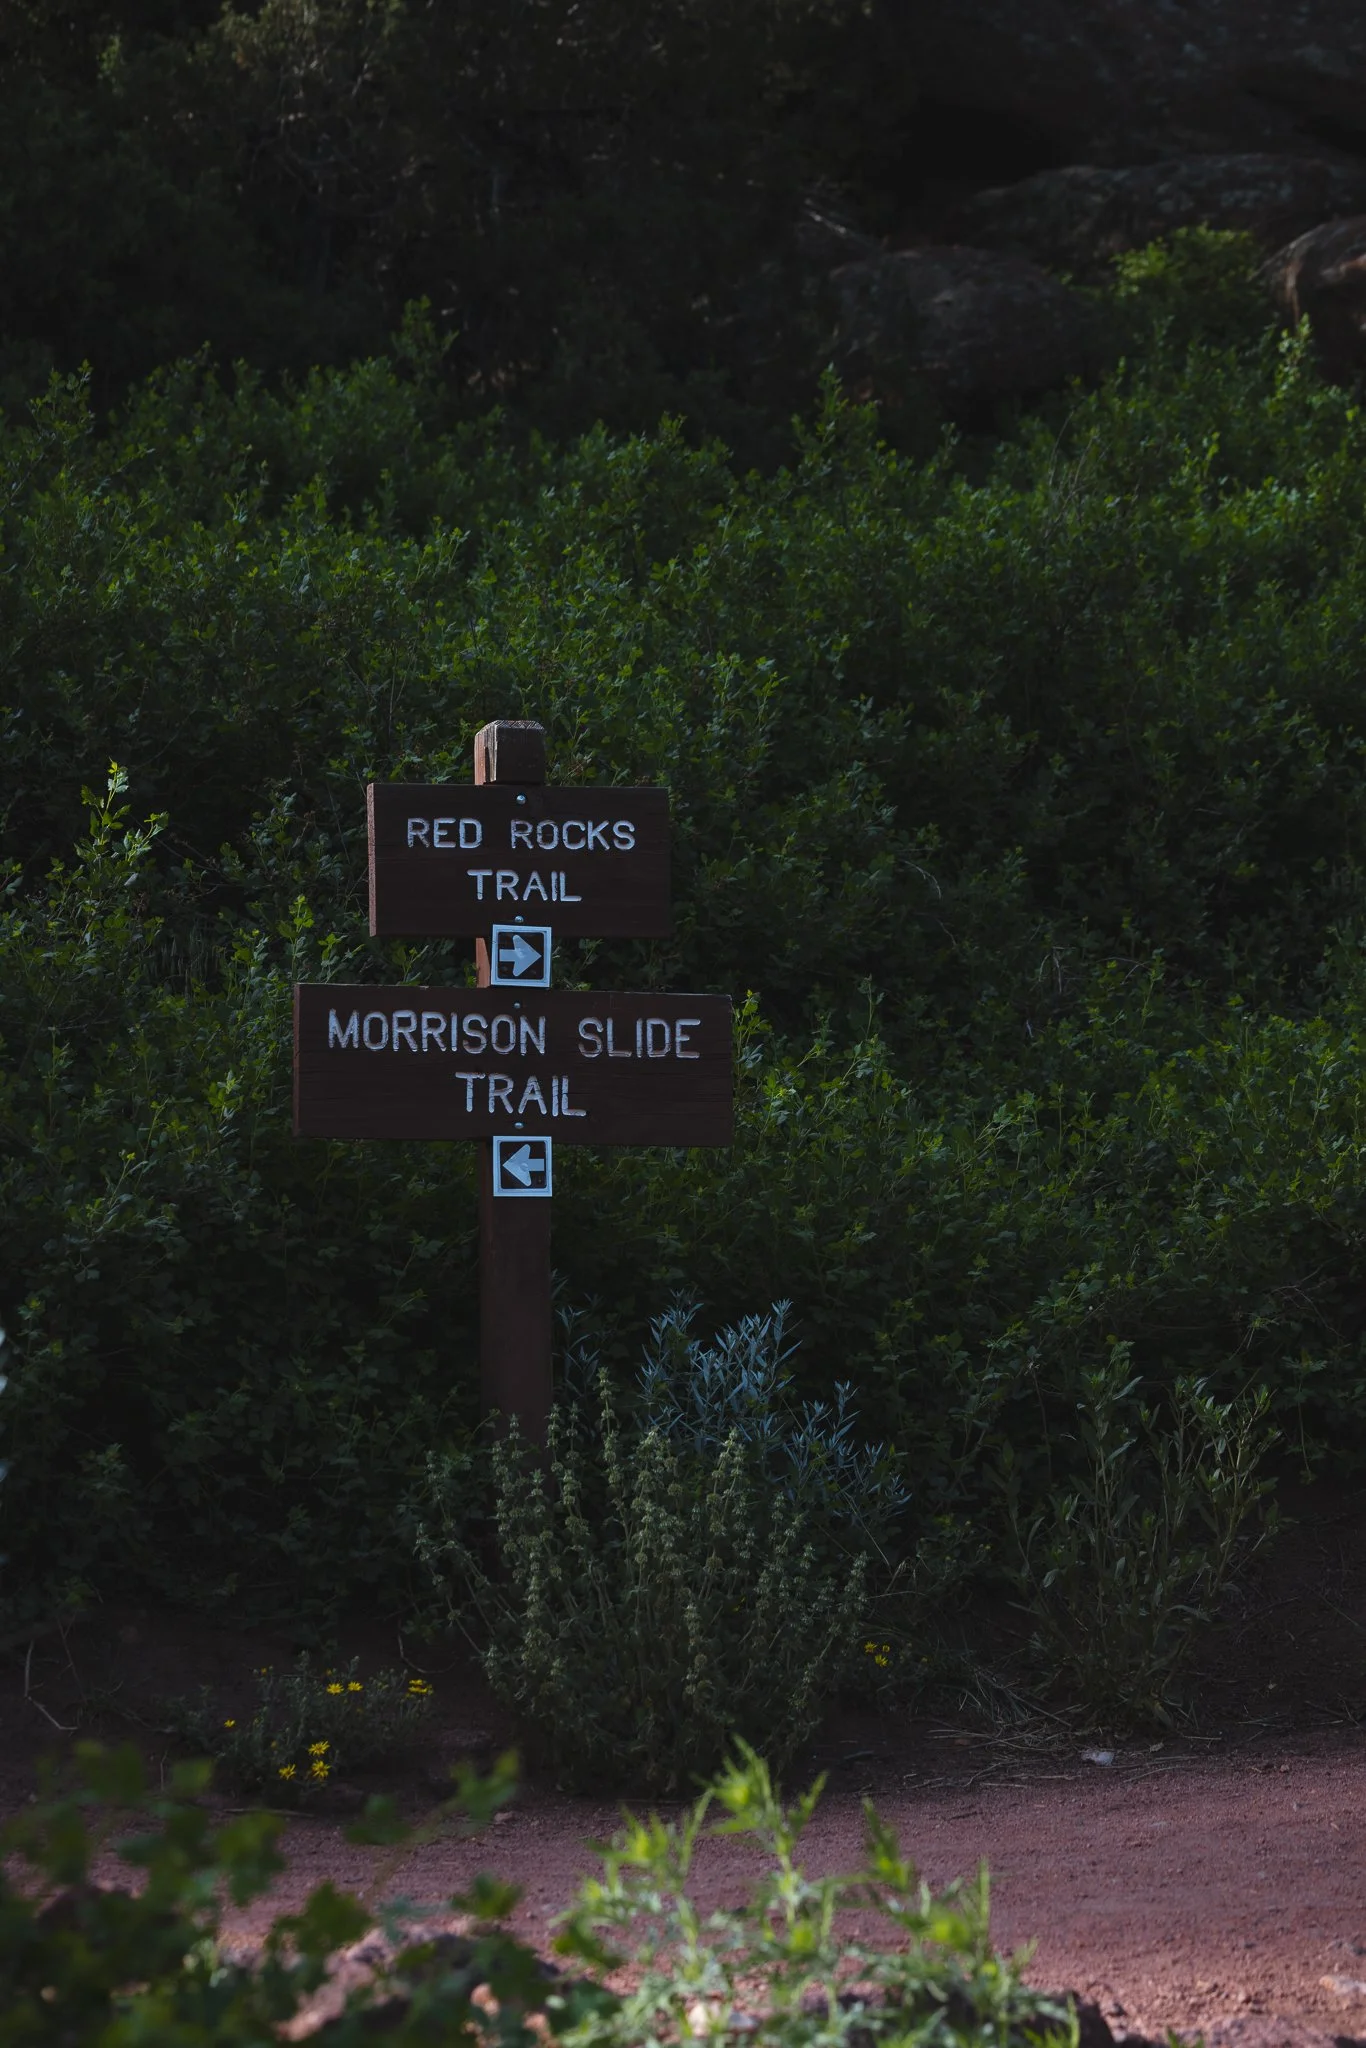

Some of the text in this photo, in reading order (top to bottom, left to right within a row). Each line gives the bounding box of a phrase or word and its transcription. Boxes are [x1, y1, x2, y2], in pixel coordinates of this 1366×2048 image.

[407, 818, 637, 851] RED ROCKS
[467, 869, 582, 902] TRAIL
[328, 1009, 701, 1059] MORRISON SLIDE
[455, 1072, 587, 1117] TRAIL
